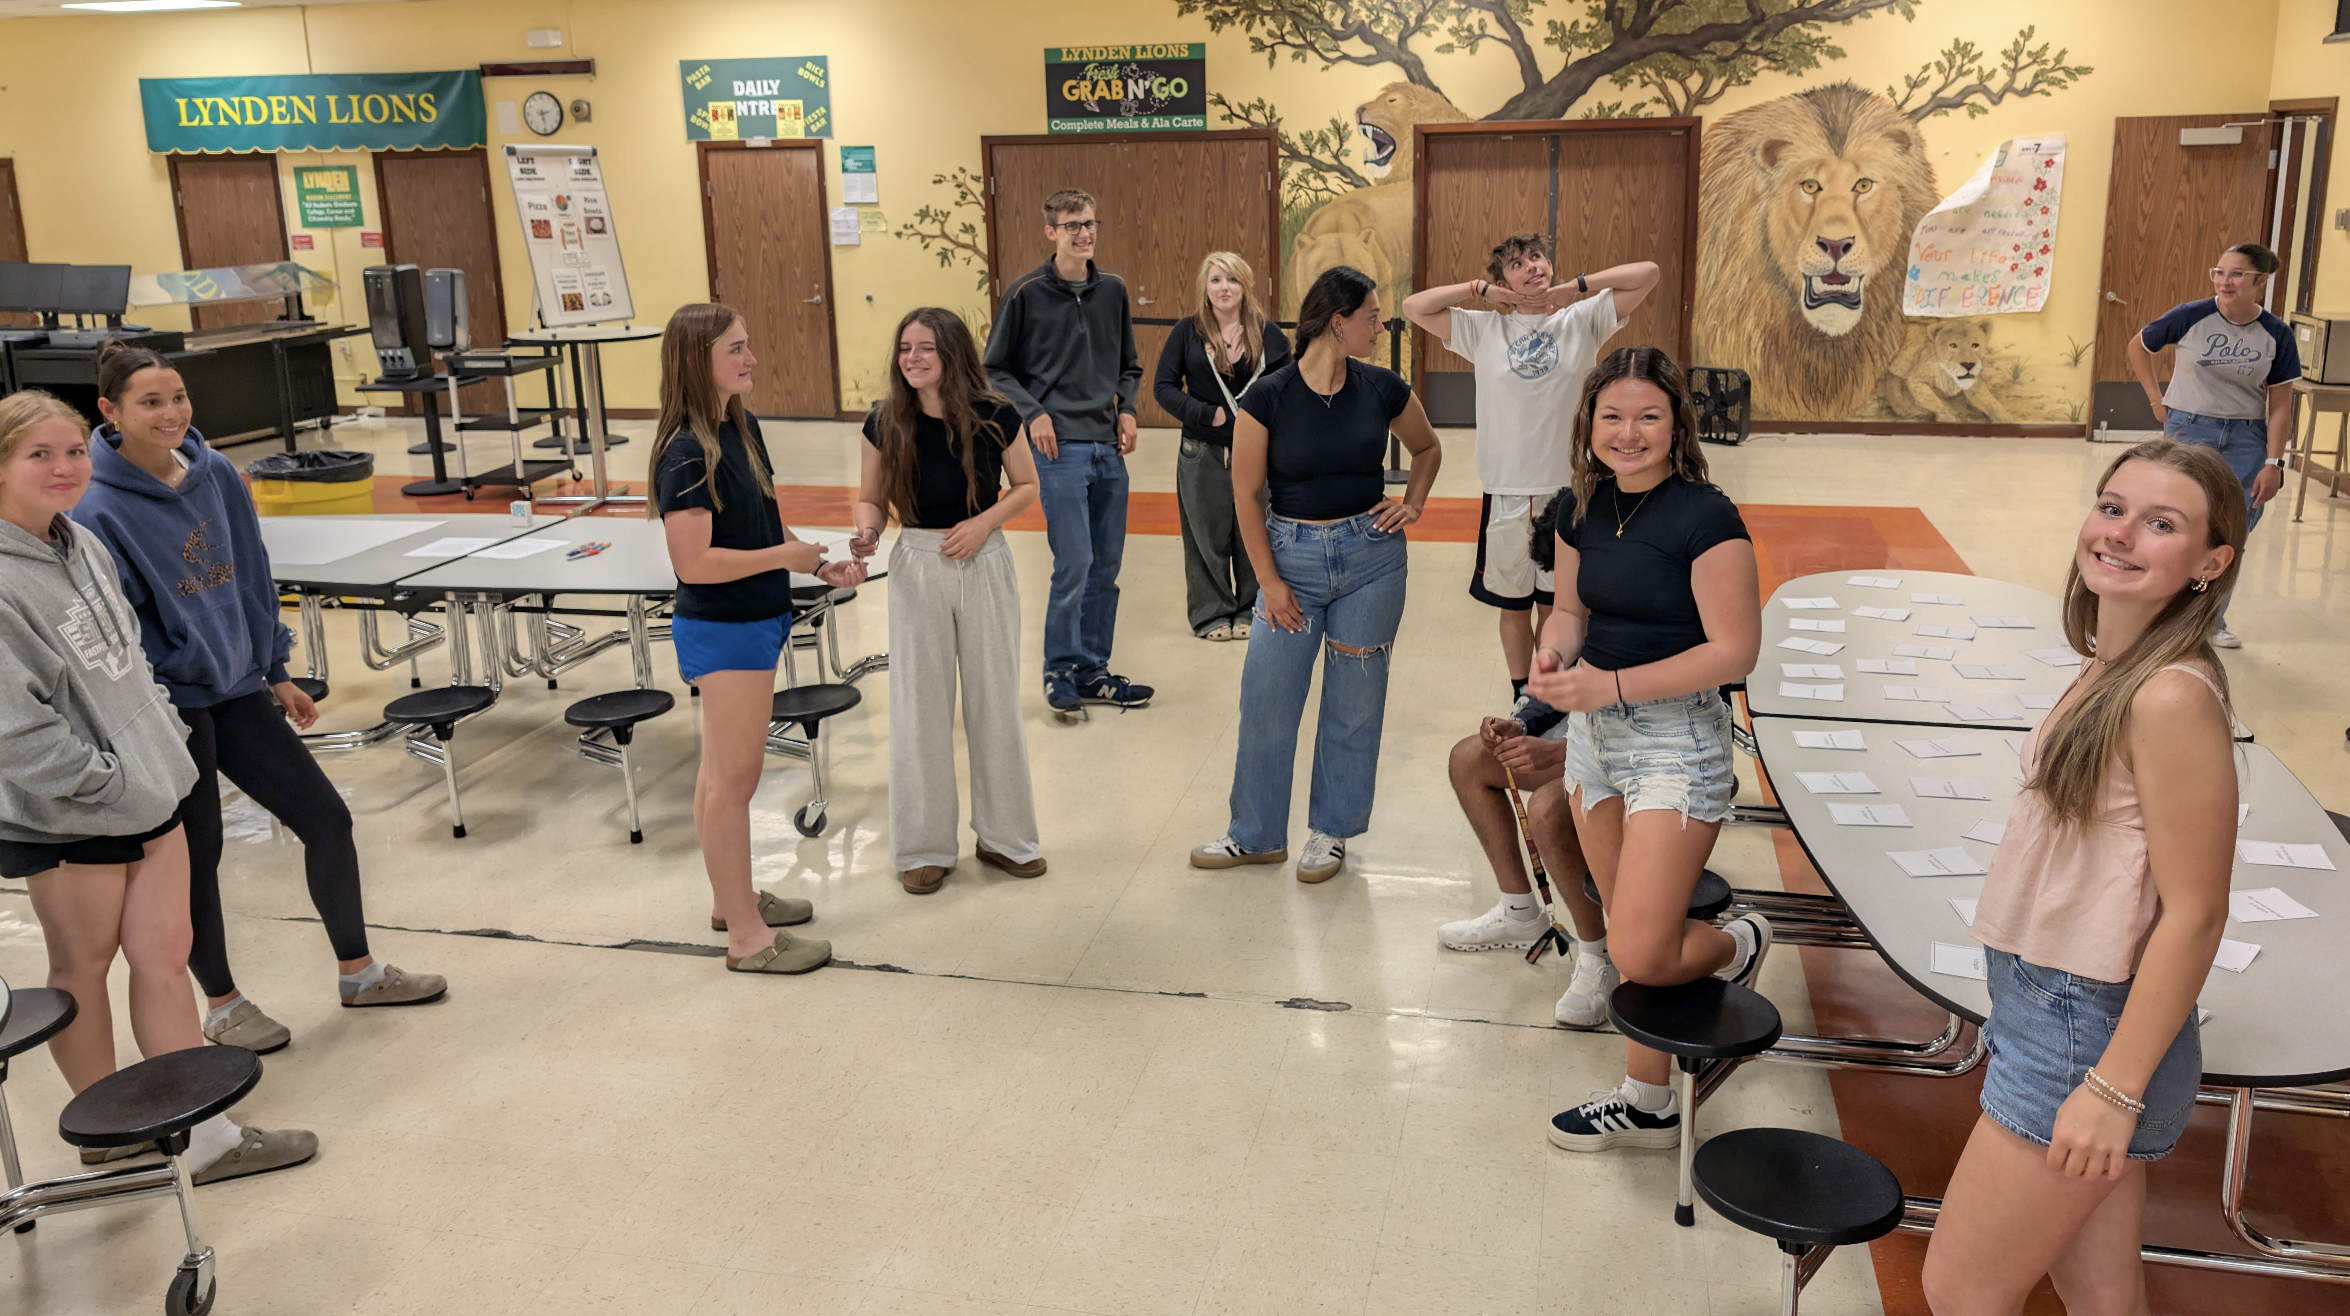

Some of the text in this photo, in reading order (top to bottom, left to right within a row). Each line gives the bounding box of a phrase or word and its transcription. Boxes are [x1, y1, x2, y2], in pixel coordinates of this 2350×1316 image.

[1061, 44, 1189, 61] LYNDEN LIONS
[686, 64, 711, 85] PASTA
[797, 66, 826, 89] BOWLS
[805, 61, 826, 78] RICE
[1085, 62, 1120, 81] Fresh
[695, 75, 712, 90] BAR
[732, 79, 781, 96] DAILY
[1062, 79, 1125, 101] GRAB
[175, 92, 438, 127] LYNDEN LIONS
[736, 100, 777, 117] NTRE
[810, 117, 828, 133] BAR
[1050, 117, 1204, 132] Complete Meals & Ala Carte
[568, 158, 592, 166] RGHT
[302, 170, 349, 189] LYNDEN
[528, 202, 547, 211] Pizza
[1915, 242, 1952, 263] Your
[1938, 268, 2002, 283] makes
[2202, 333, 2259, 358] Polo
[1097, 684, 1117, 699] N
